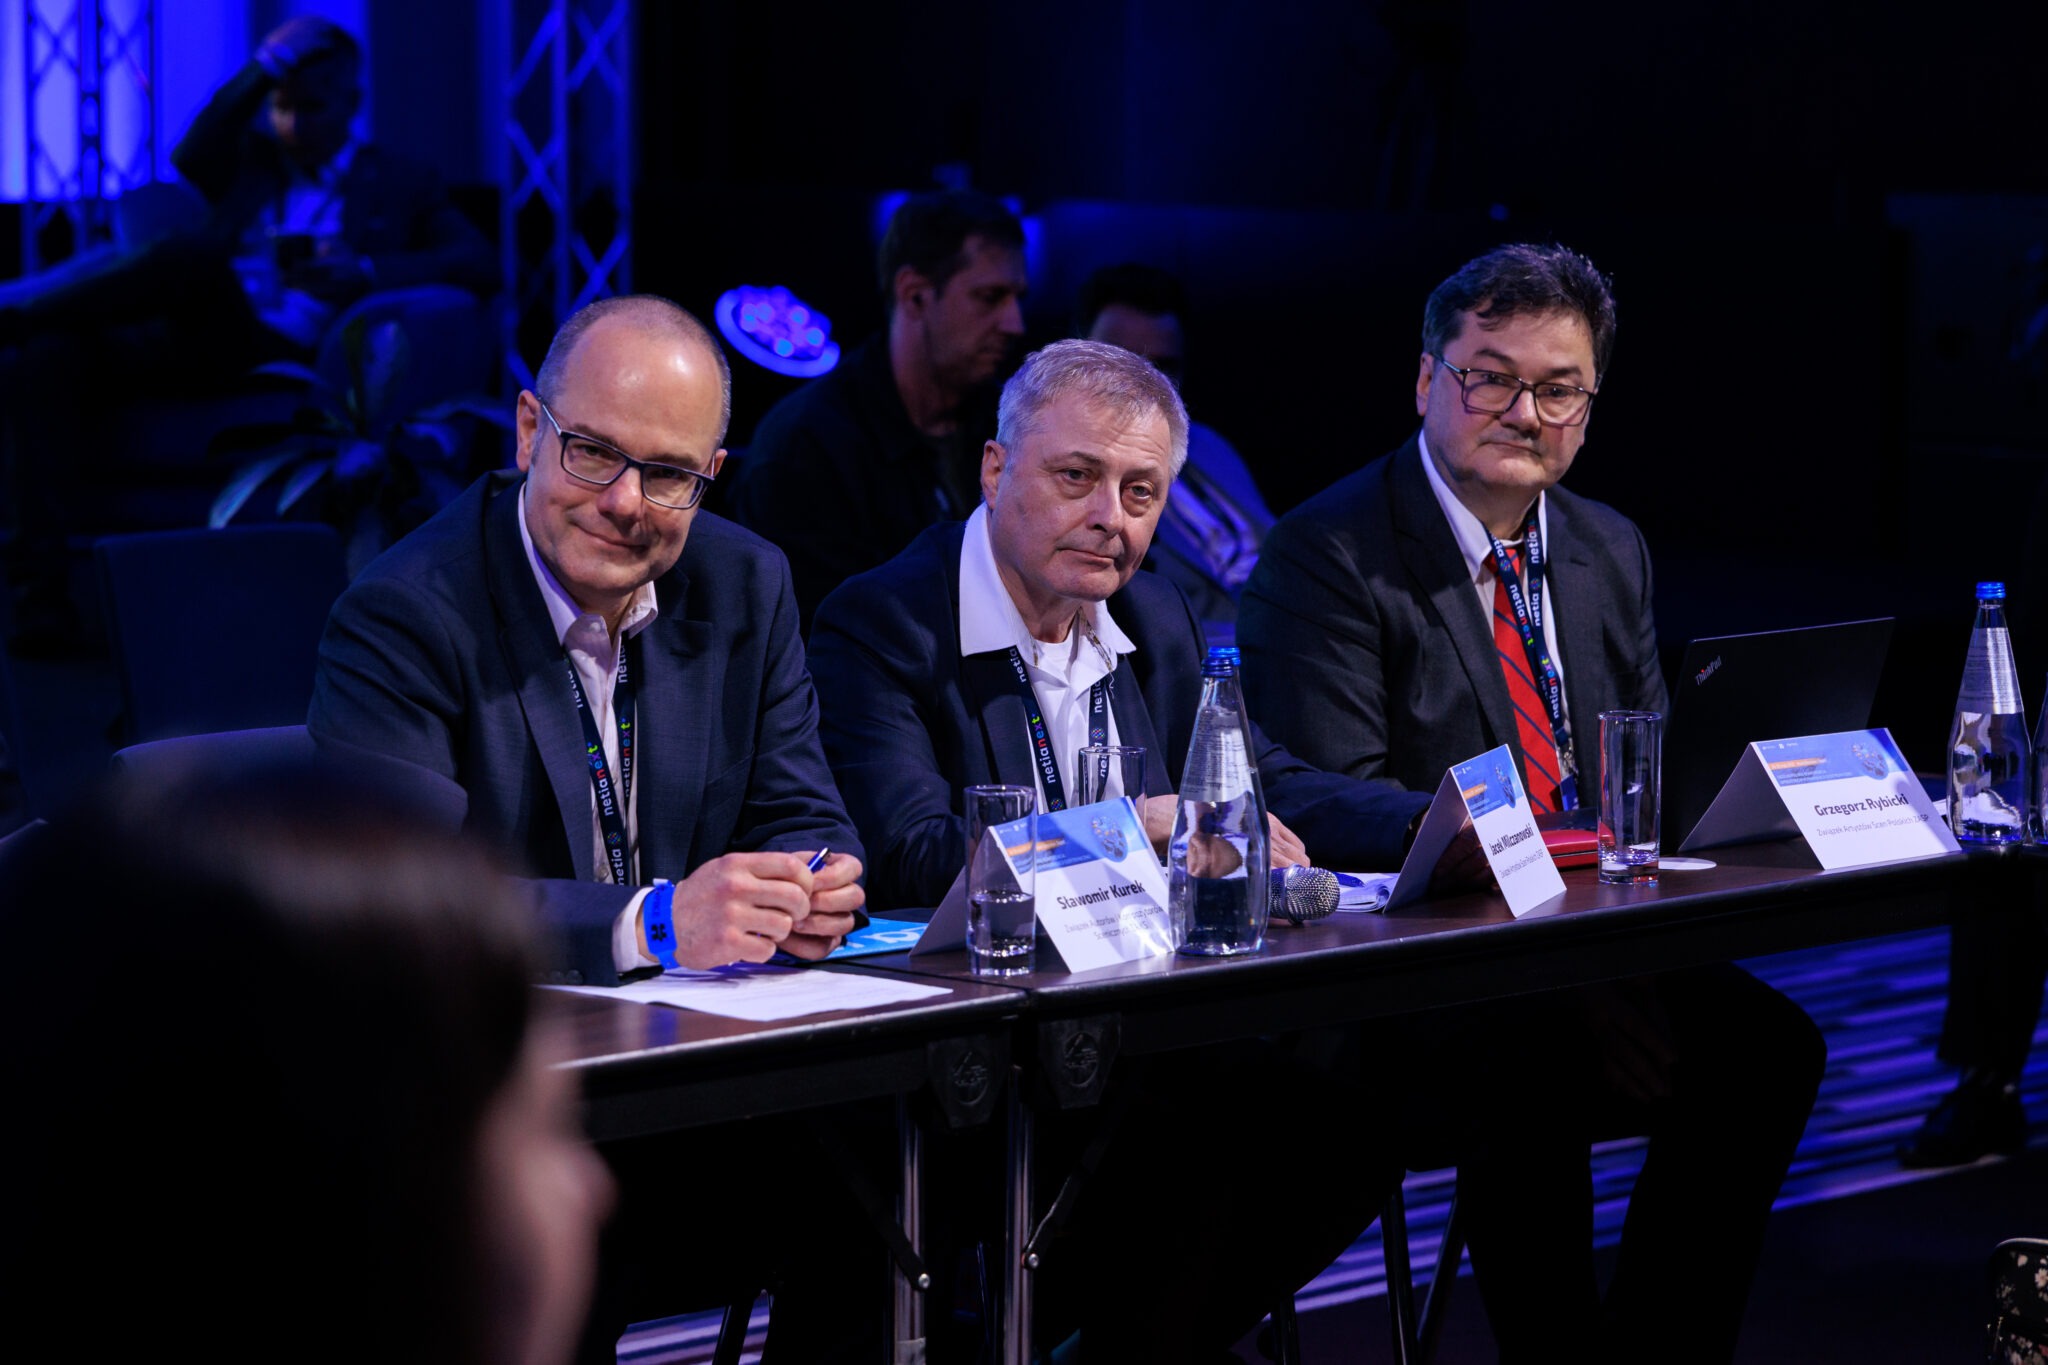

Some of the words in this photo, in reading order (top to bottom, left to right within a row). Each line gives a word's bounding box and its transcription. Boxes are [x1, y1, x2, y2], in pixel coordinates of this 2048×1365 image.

[1532, 593, 1541, 626] netia
[1010, 648, 1027, 683] netia
[621, 721, 631, 797] netianext
[1031, 715, 1057, 783] netianext
[588, 744, 614, 816] netianext
[1814, 801, 1867, 816] Grzegorz
[1865, 793, 1909, 811] Rybicki
[1489, 838, 1504, 856] Jacek
[1057, 888, 1110, 910] Sławomir
[1109, 880, 1146, 899] Kurek
